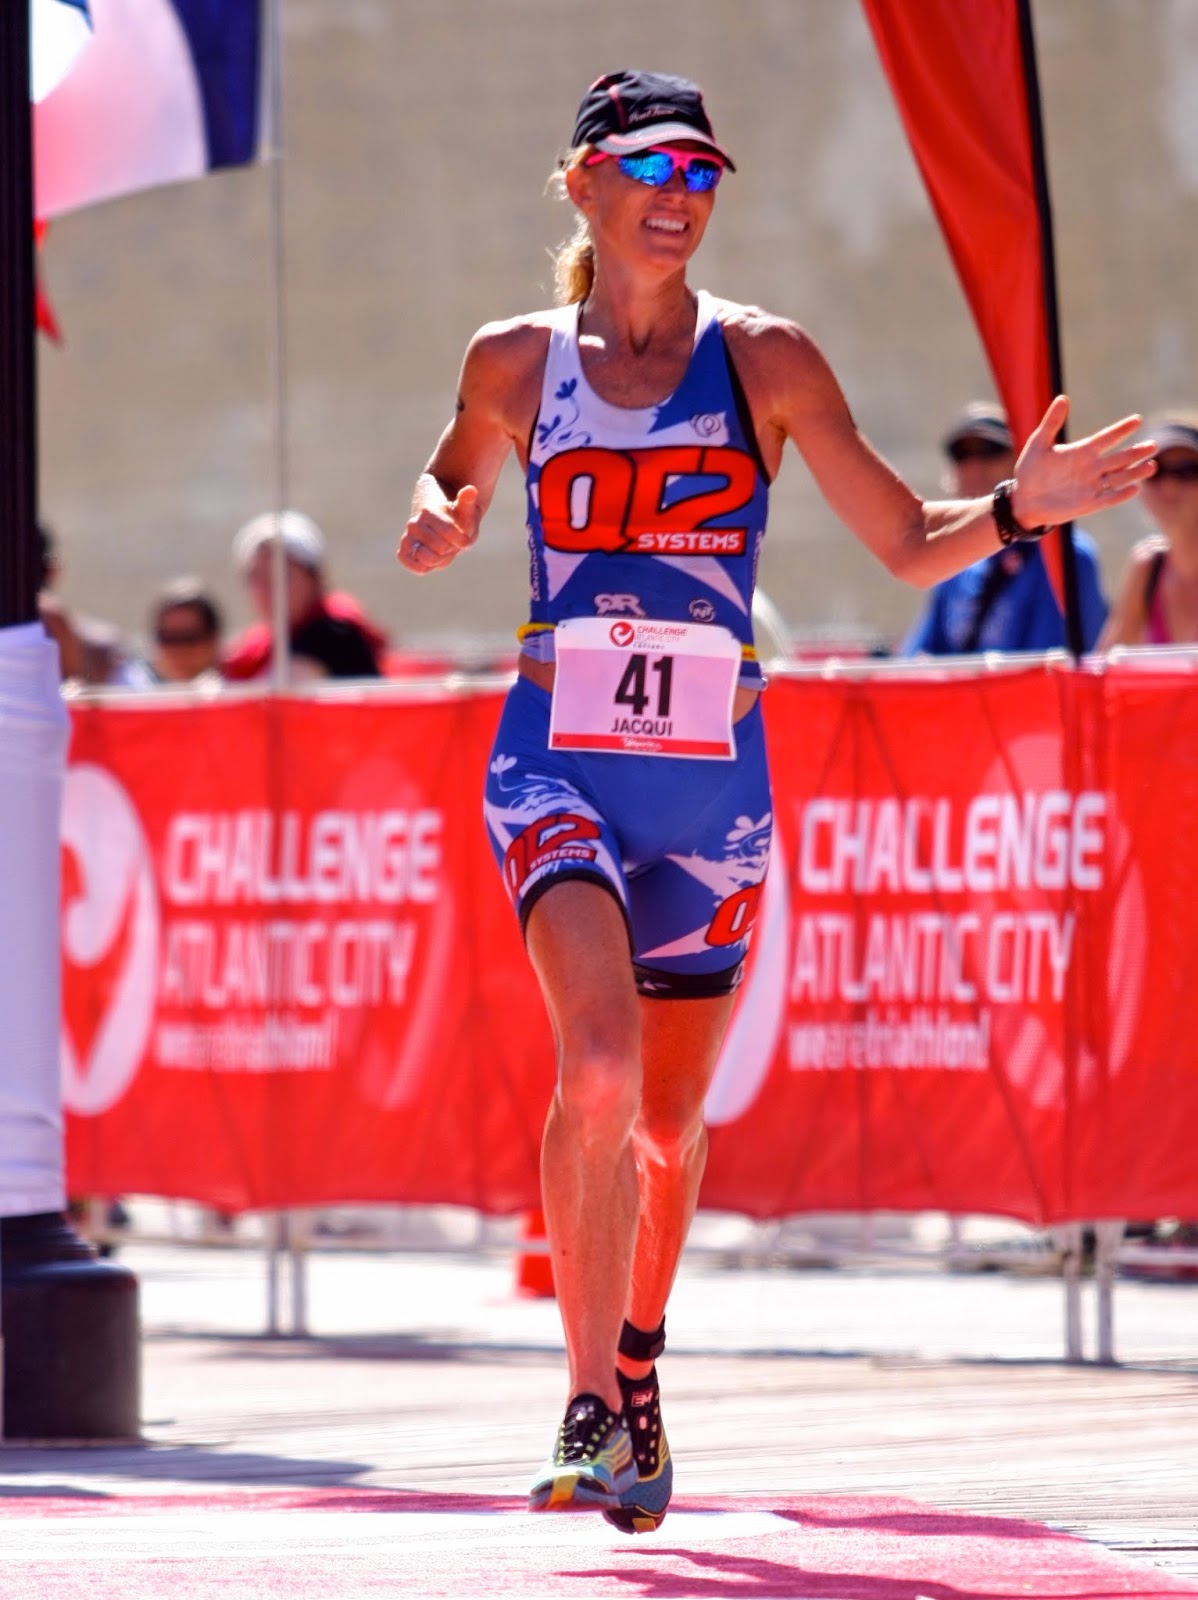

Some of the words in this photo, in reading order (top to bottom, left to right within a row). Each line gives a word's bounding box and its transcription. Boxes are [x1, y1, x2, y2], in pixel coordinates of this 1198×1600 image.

[637, 532, 740, 551] SYSTEMS
[636, 625, 688, 636] CHALLENGE
[614, 654, 673, 718] 41
[611, 717, 673, 736] JACQUI
[165, 811, 442, 904] CHALLENGE
[529, 849, 591, 871] SYSTEMS
[803, 791, 1107, 894] CHALLENGE
[160, 921, 325, 1008] ATLANTIC
[331, 921, 417, 1008] CITY
[790, 914, 979, 1003] ATLANTIC
[988, 911, 1076, 1003] CITY
